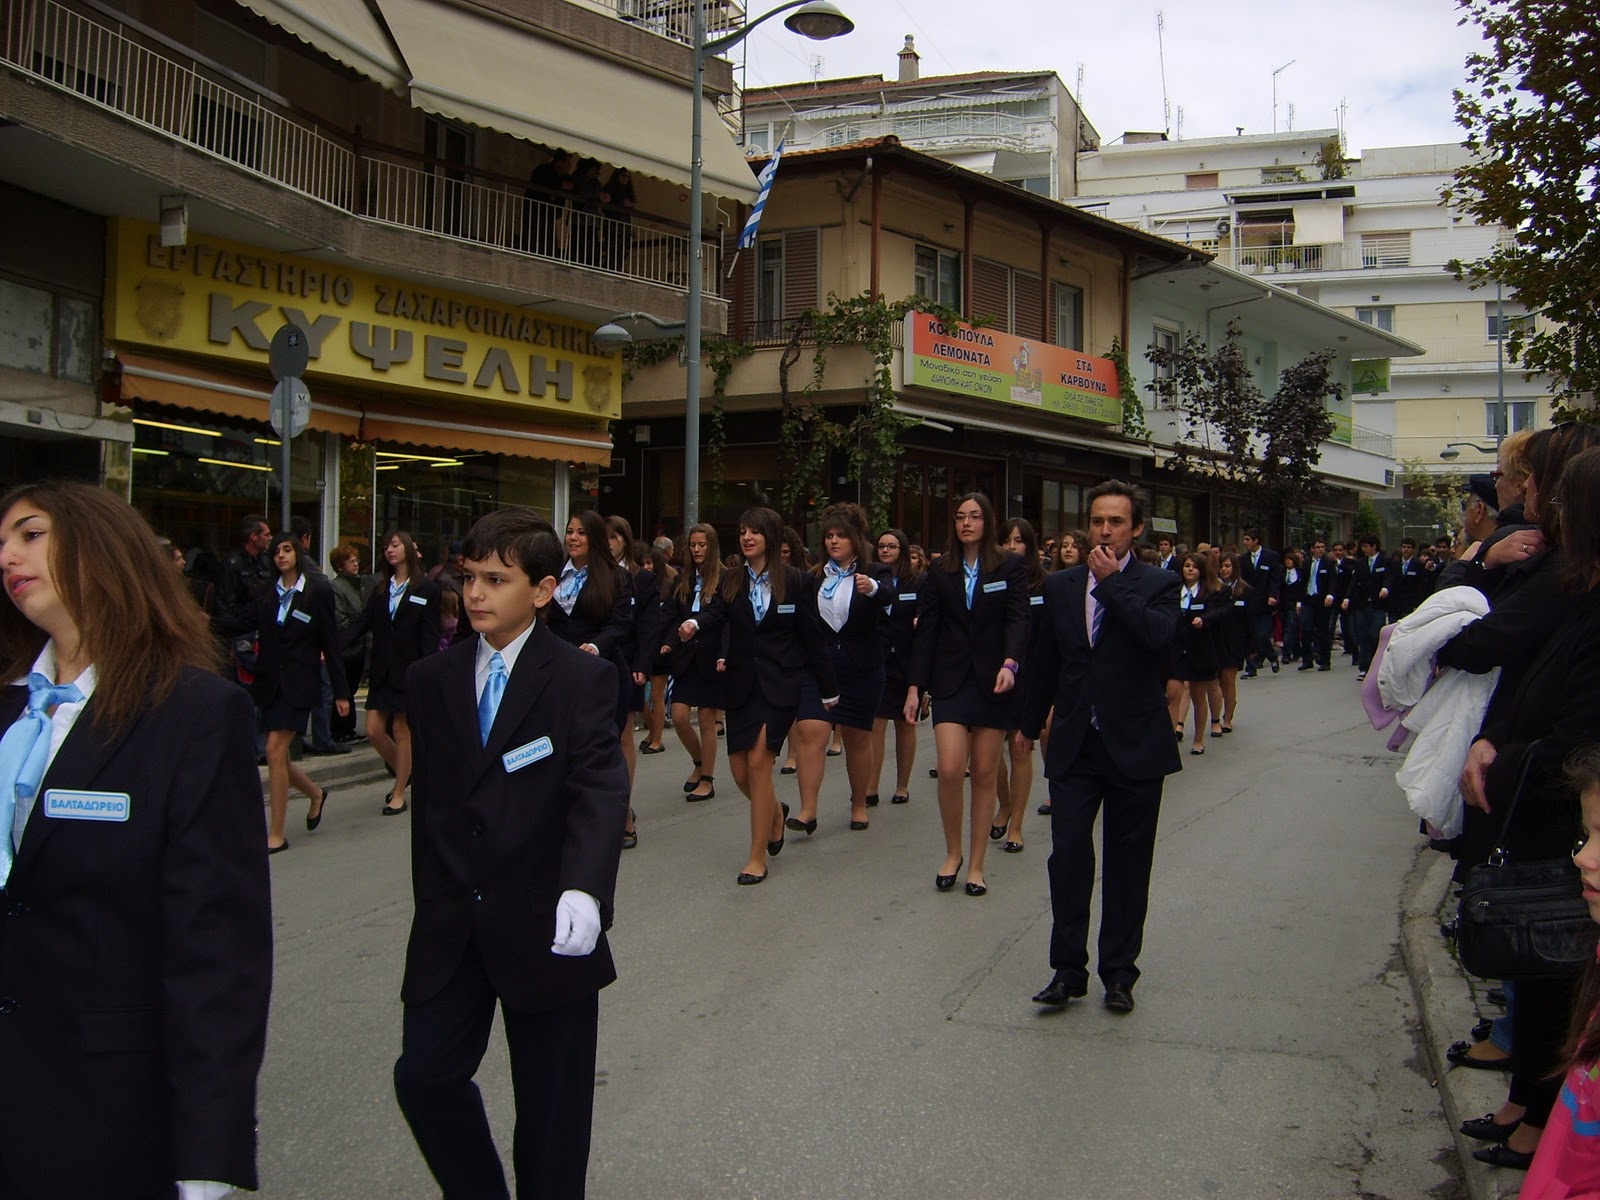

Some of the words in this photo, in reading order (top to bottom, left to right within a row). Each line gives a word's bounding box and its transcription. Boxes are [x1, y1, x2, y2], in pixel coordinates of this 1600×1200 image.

[146, 234, 354, 306] ΕΡΓΑΣΤΗΡΙΟ
[375, 284, 614, 359] ΖΑΧΑΡΟΠΛΑΣΤΙΚΗ
[928, 321, 994, 347] ΚΟΠΟΥΛΑ
[208, 292, 574, 402] ΚΥΨΕΛΗ
[932, 343, 991, 366] ΛΕΜΟΝΑΤΑ
[920, 359, 960, 375] Μοναδικό
[1076, 359, 1093, 373] ΣΤΑ
[1061, 373, 1107, 393] ΚΑΡΒΟΥΝΑ
[51, 800, 124, 812] ΒΑΛΤΑΔΩΡΕΙΟ
